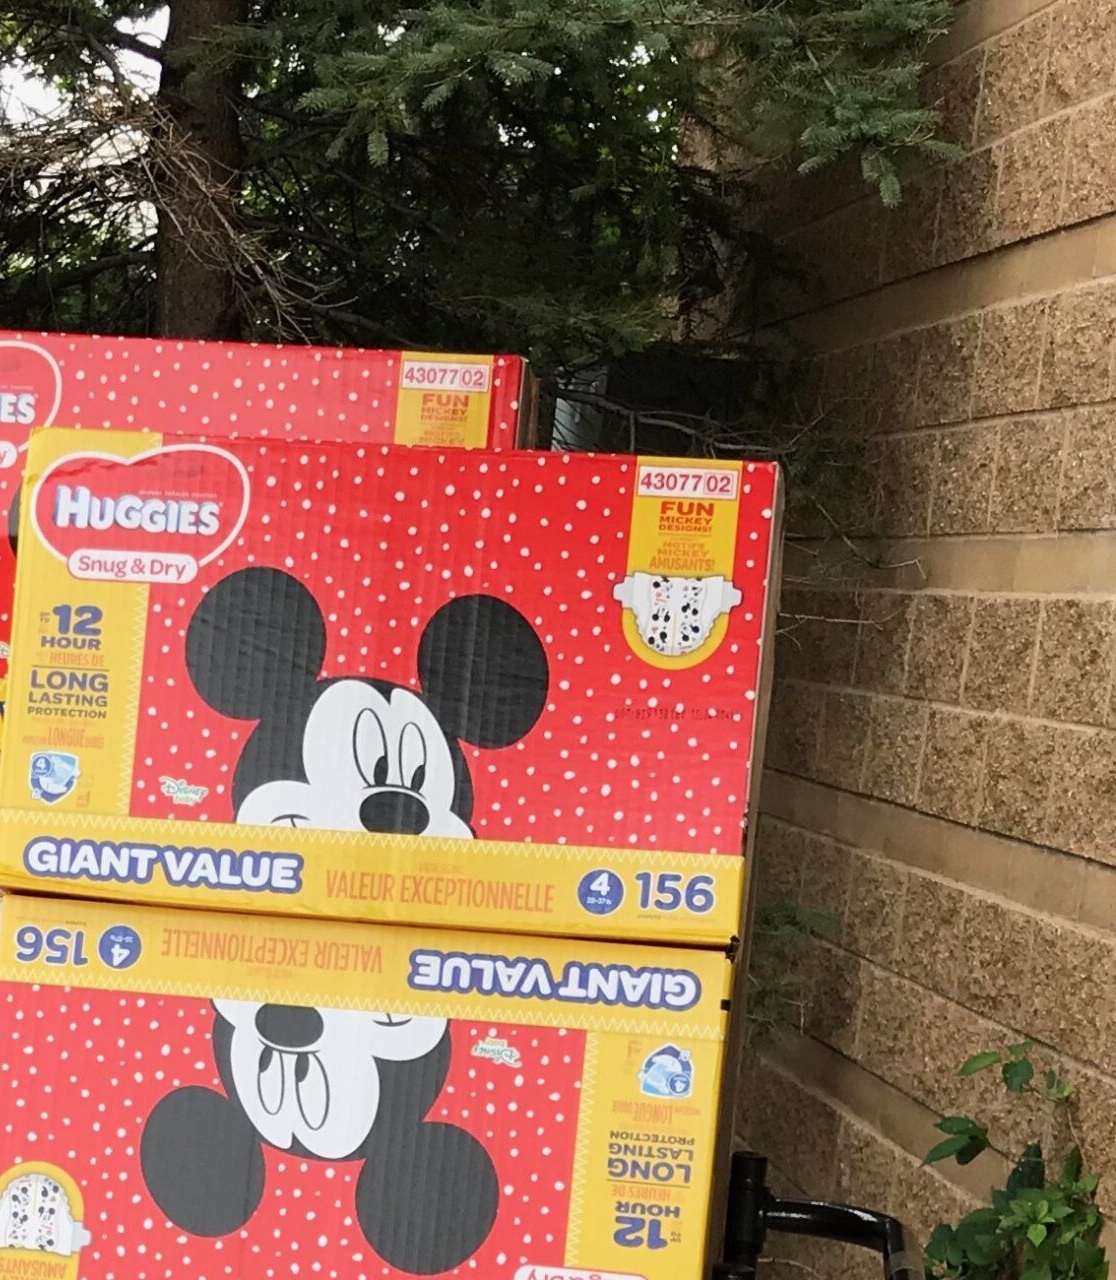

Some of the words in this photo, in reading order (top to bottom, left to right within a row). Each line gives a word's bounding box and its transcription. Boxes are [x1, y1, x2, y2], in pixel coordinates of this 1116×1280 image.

[422, 394, 469, 407] FUN
[54, 485, 220, 536] HUGGIES
[661, 500, 714, 517] FUN
[658, 524, 713, 533] DESIGNS!
[659, 516, 713, 526] MICKEY
[78, 556, 127, 577] Snug
[131, 559, 146, 575] &
[149, 560, 187, 583] Dry
[649, 556, 715, 572] AMUSANTS!
[52, 604, 104, 637] 12
[41, 636, 102, 651] HOUR
[49, 652, 90, 666] HEURES
[92, 653, 105, 667] DE
[31, 670, 109, 693] LONG
[28, 692, 109, 708] LASTING
[27, 707, 107, 719] PROTECTION
[28, 841, 157, 880] GIANT
[163, 848, 299, 890] VALUE
[325, 870, 395, 902] VALEUR
[400, 874, 555, 914] EXCEPTIONNELLE
[590, 872, 610, 896] 4
[635, 872, 716, 914] 156
[16, 926, 88, 966] 156
[110, 943, 131, 967] 4
[161, 928, 308, 968] EXCEPTIONNELLE
[313, 940, 384, 974] VALEUR
[414, 954, 553, 995] VALUE
[559, 963, 698, 1006] GIANT
[609, 1130, 695, 1146] PROTECTION
[608, 1143, 694, 1162] LASTING
[607, 1158, 692, 1183] LONG
[612, 1186, 626, 1199] DE
[628, 1187, 671, 1202] HEURES
[615, 1201, 681, 1218] HOUR
[613, 1216, 668, 1250] 12
